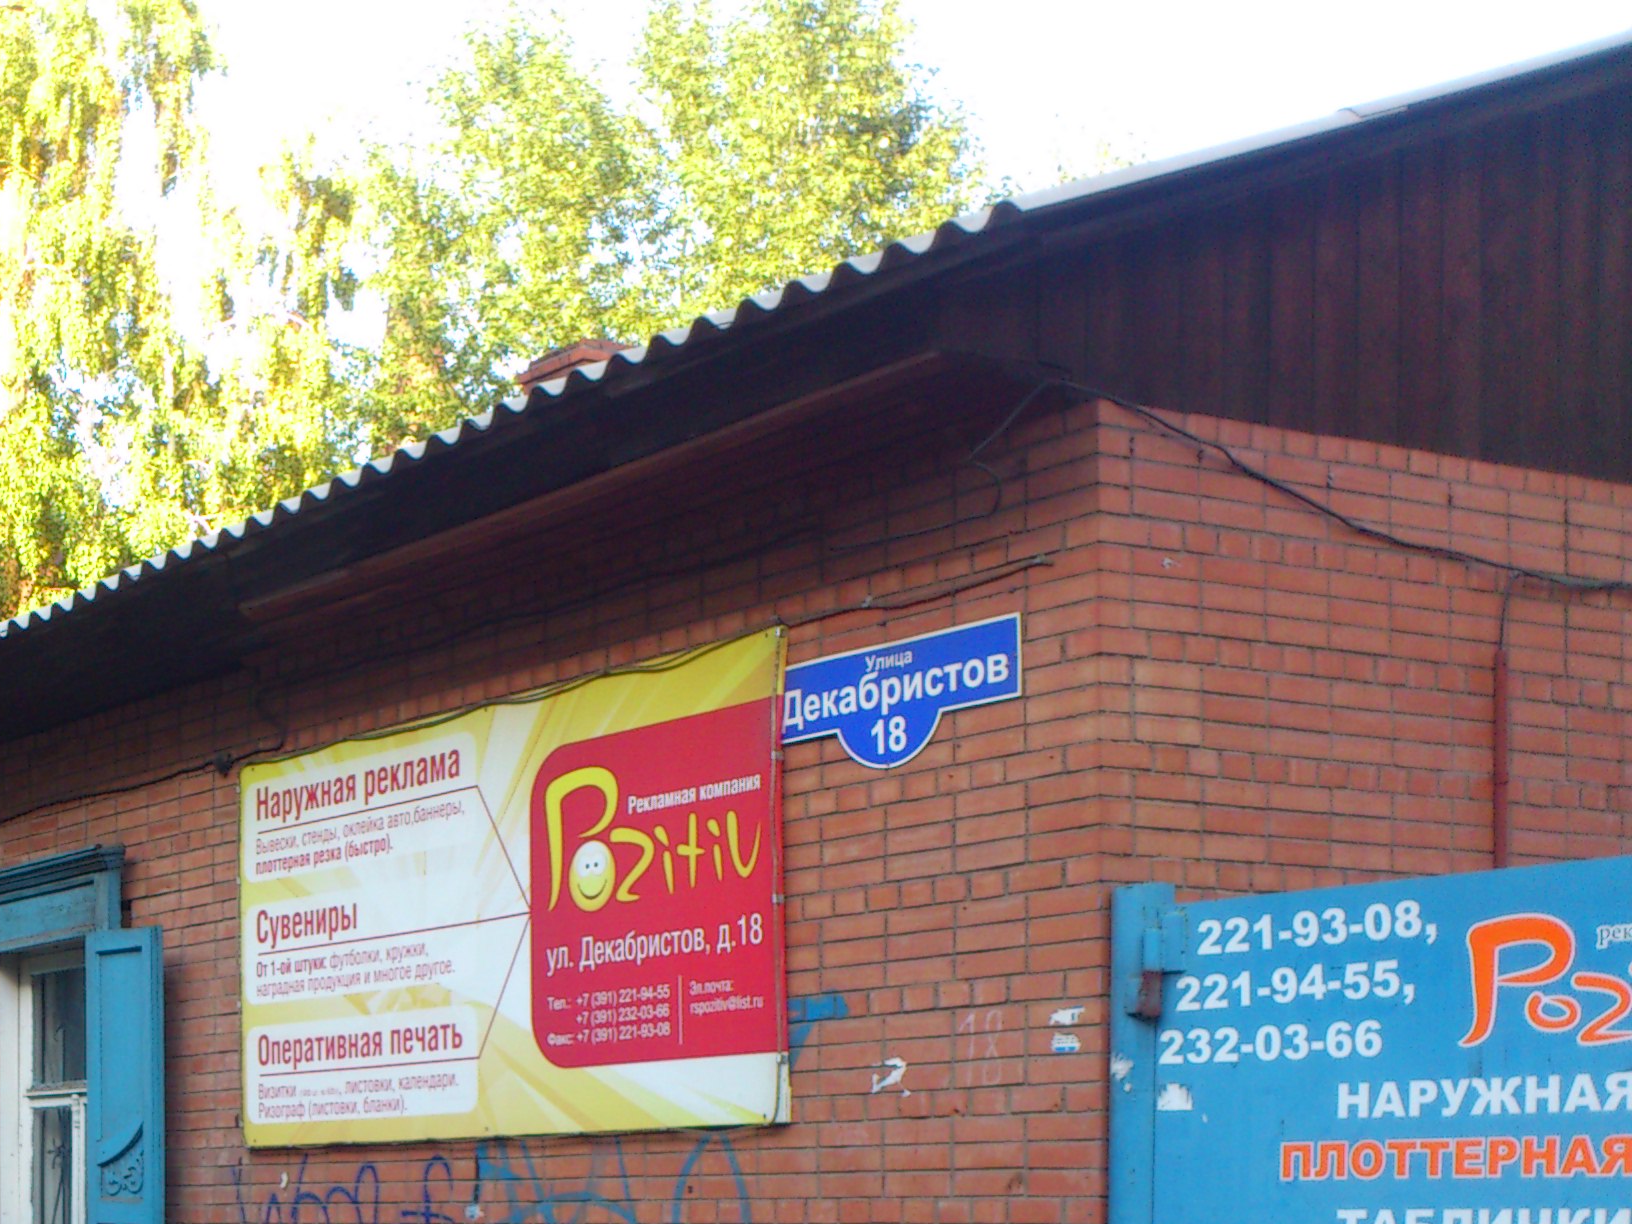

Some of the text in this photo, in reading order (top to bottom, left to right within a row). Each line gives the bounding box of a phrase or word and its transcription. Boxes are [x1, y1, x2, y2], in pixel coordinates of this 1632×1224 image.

[865, 650, 913, 672] Улица
[782, 653, 1009, 733] Декабристов
[871, 716, 907, 755] 18
[256, 749, 461, 822] Наружная реклама
[627, 774, 761, 814] Рекламная компания
[256, 852, 311, 875] плоттерная
[313, 846, 341, 867] резка
[256, 902, 358, 949] Сувениры
[1196, 899, 1438, 955] 221-93-08,
[256, 961, 268, 978] От
[270, 960, 292, 976] 1-ой
[546, 947, 574, 977] ул.
[578, 927, 711, 972] Декабристов,
[363, 970, 371, 984] и
[374, 966, 412, 982] многое
[1175, 959, 1415, 1012] 221-94-55,
[1457, 912, 1632, 1048] Poz
[576, 992, 589, 1007] +7
[576, 1011, 589, 1025] +7
[258, 1023, 463, 1070] Оперативная печать
[577, 1028, 589, 1043] +7
[1158, 1019, 1383, 1065] 232-03-66
[258, 1083, 297, 1100] Визитки
[258, 1101, 305, 1119] Ризограф
[1337, 1071, 1632, 1119] НАРУЖНАЯ
[1278, 1132, 1632, 1182] ПЛОТТЕРНАЯ
